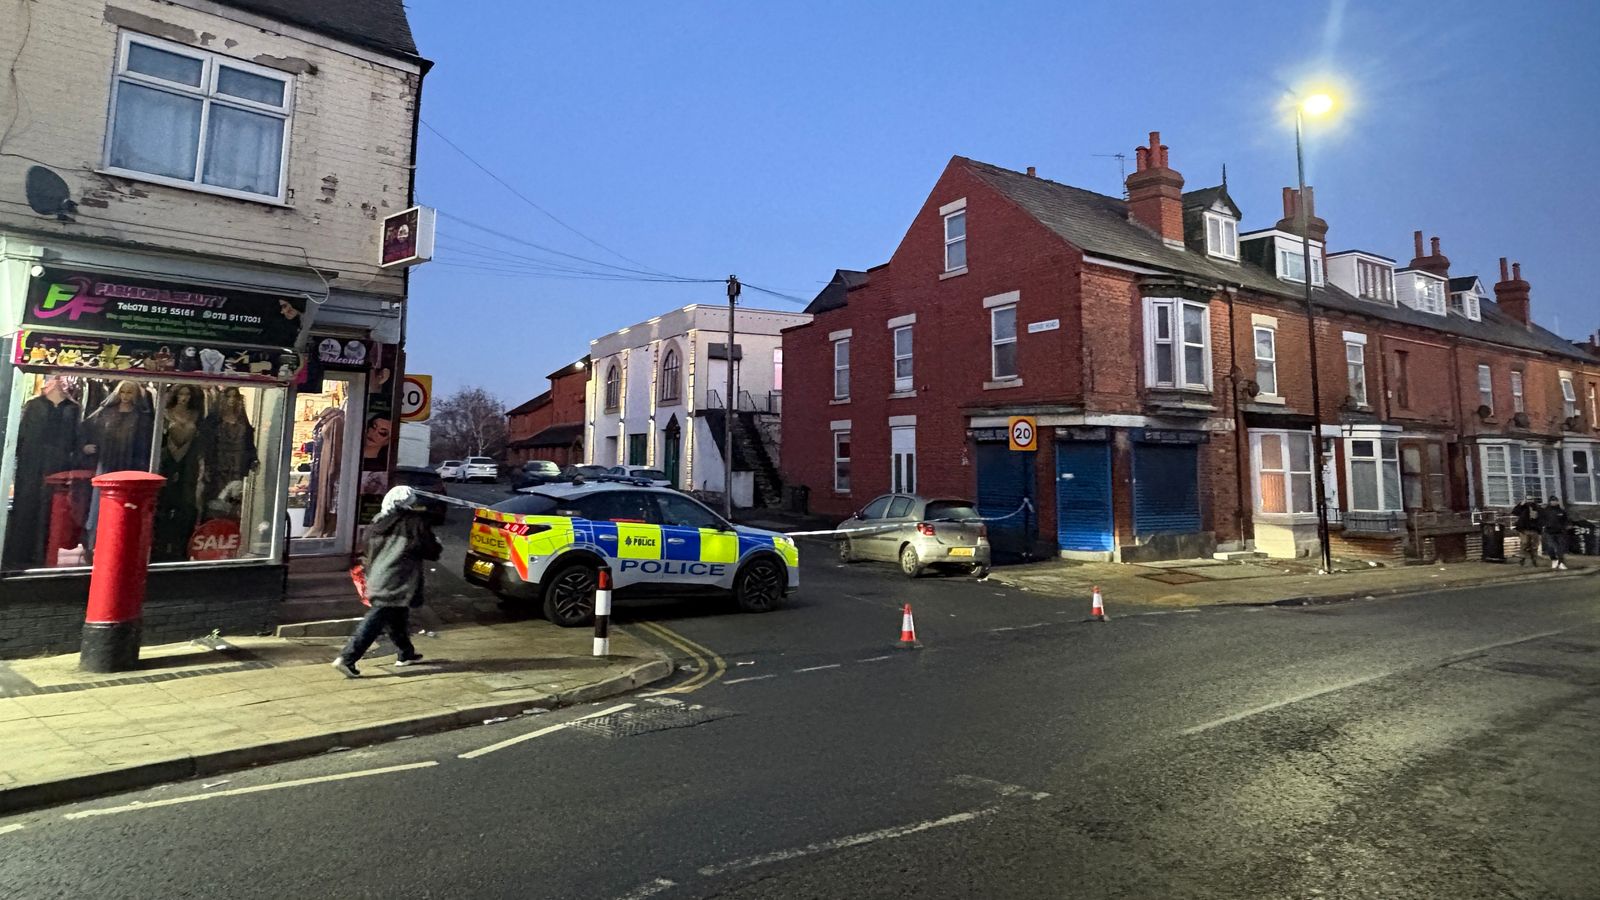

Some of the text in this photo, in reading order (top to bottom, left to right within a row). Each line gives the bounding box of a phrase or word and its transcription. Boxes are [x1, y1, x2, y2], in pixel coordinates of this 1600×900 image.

[320, 355, 365, 365] Welcome
[1015, 427, 1031, 440] 20
[191, 534, 239, 551] SALE
[633, 538, 656, 547] POLICE
[620, 559, 726, 577] POLICE
